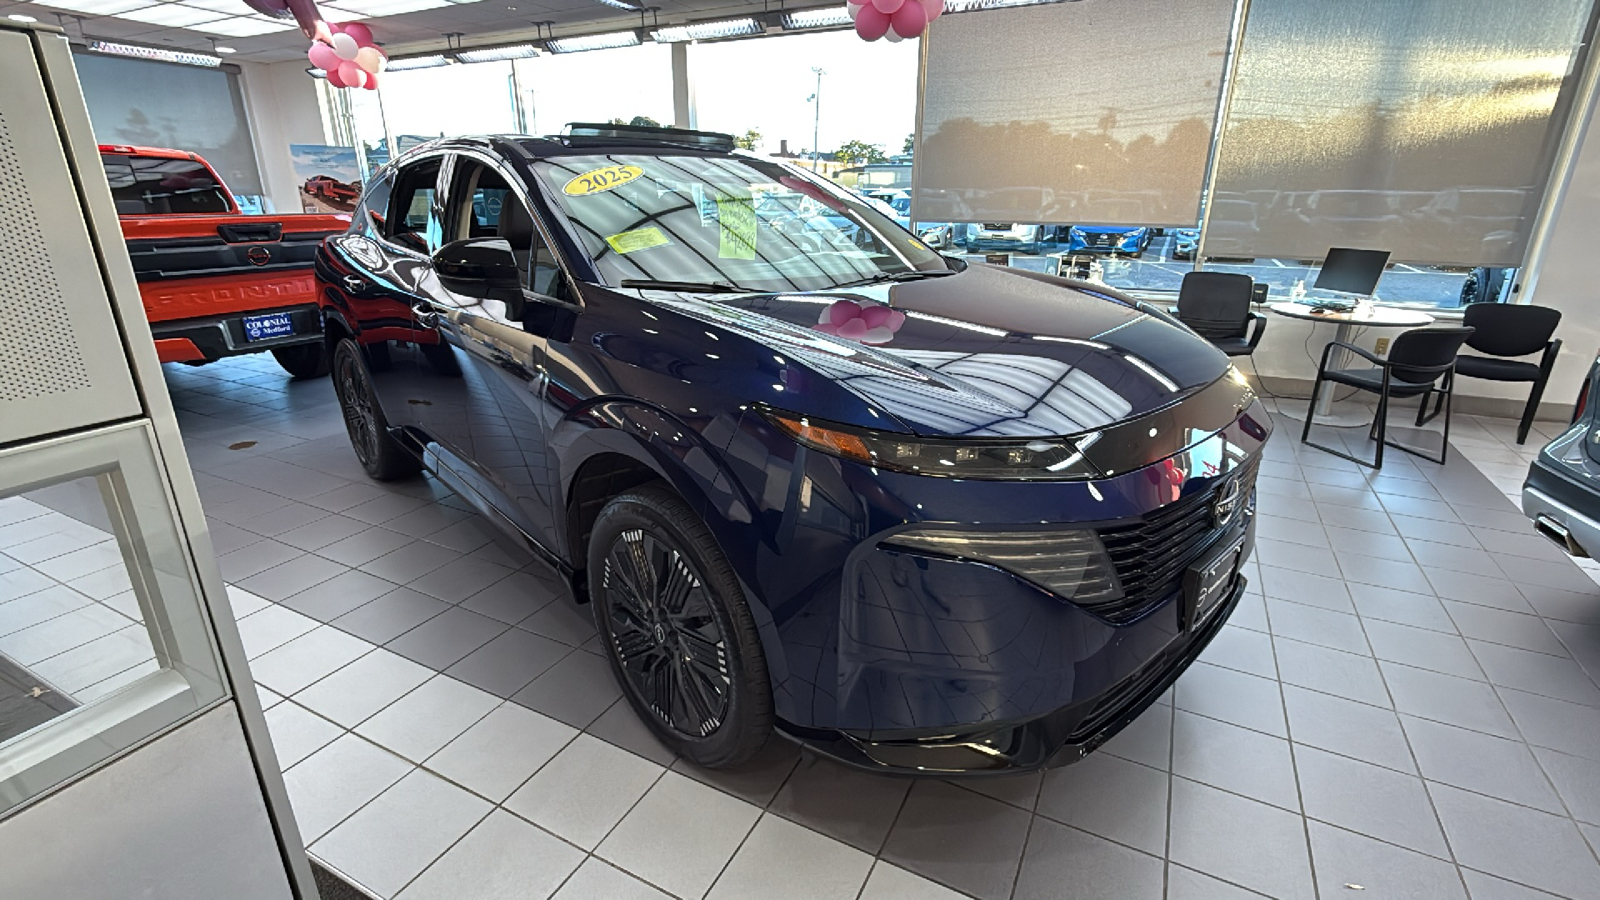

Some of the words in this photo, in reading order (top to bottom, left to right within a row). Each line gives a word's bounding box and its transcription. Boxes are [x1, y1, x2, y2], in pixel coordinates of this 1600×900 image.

[580, 166, 633, 192] 2025
[158, 279, 313, 304] FRONTI
[246, 317, 291, 330] COLONIAL
[263, 325, 291, 334] Medford
